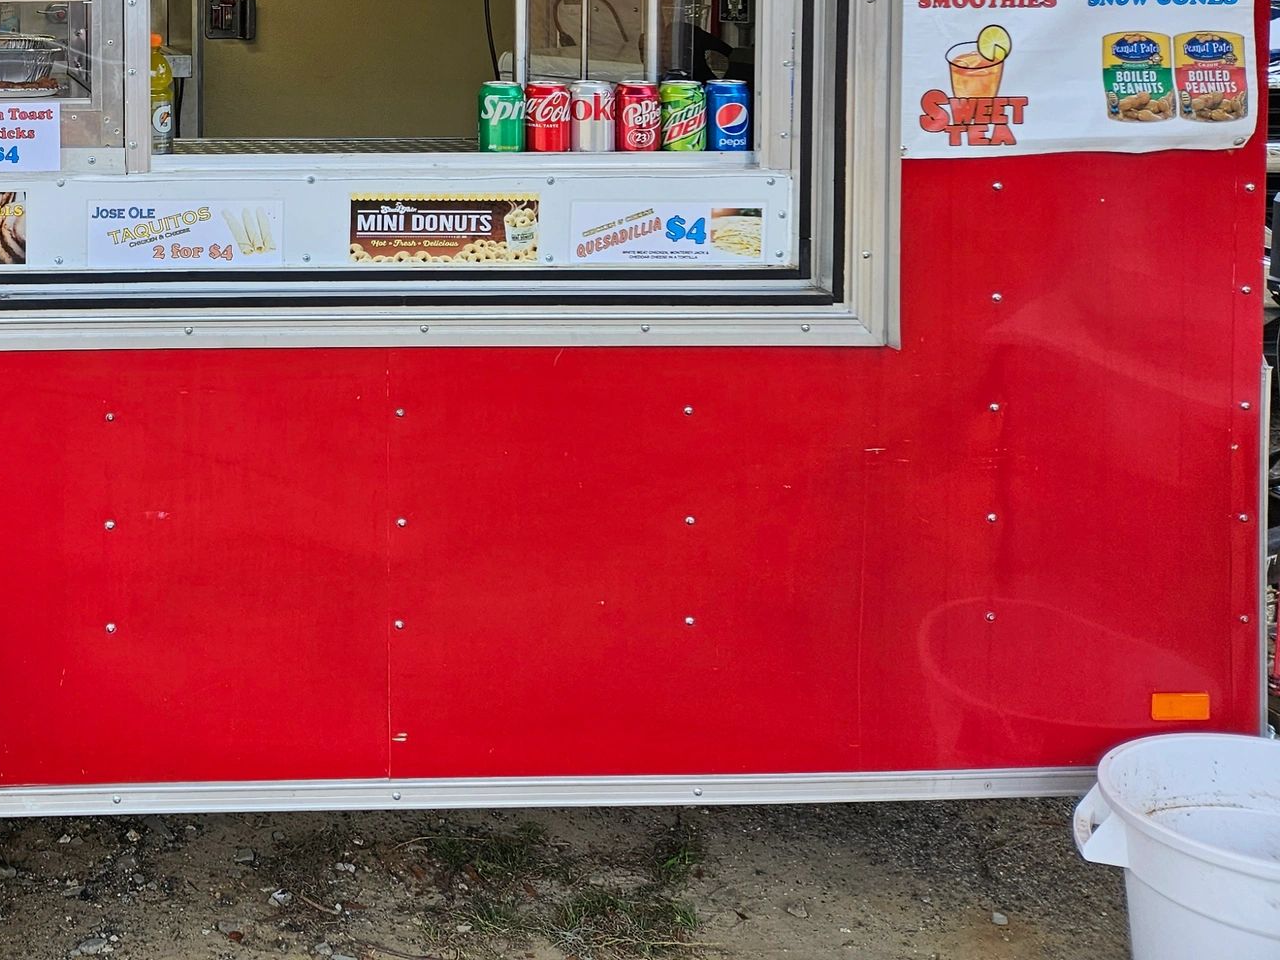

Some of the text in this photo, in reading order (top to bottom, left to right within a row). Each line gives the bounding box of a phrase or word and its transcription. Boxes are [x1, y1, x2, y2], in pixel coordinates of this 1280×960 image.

[1116, 71, 1157, 82] BOILED
[1189, 70, 1230, 81] BOILED
[1112, 82, 1164, 94] PEANUTS
[1185, 82, 1238, 93] PEANUTS
[641, 100, 657, 113] Dr
[920, 89, 1028, 133] SWEET
[8, 108, 53, 120] Toast
[945, 124, 1017, 146] TEA
[719, 137, 746, 147] pepsi
[107, 207, 211, 245] TAQUITOS
[357, 214, 493, 232] MINI DONUTS
[577, 215, 706, 258] QUESADILLIA $4
[371, 240, 459, 248] Hot Fresh Delicious
[152, 243, 233, 261] 2 for $4
